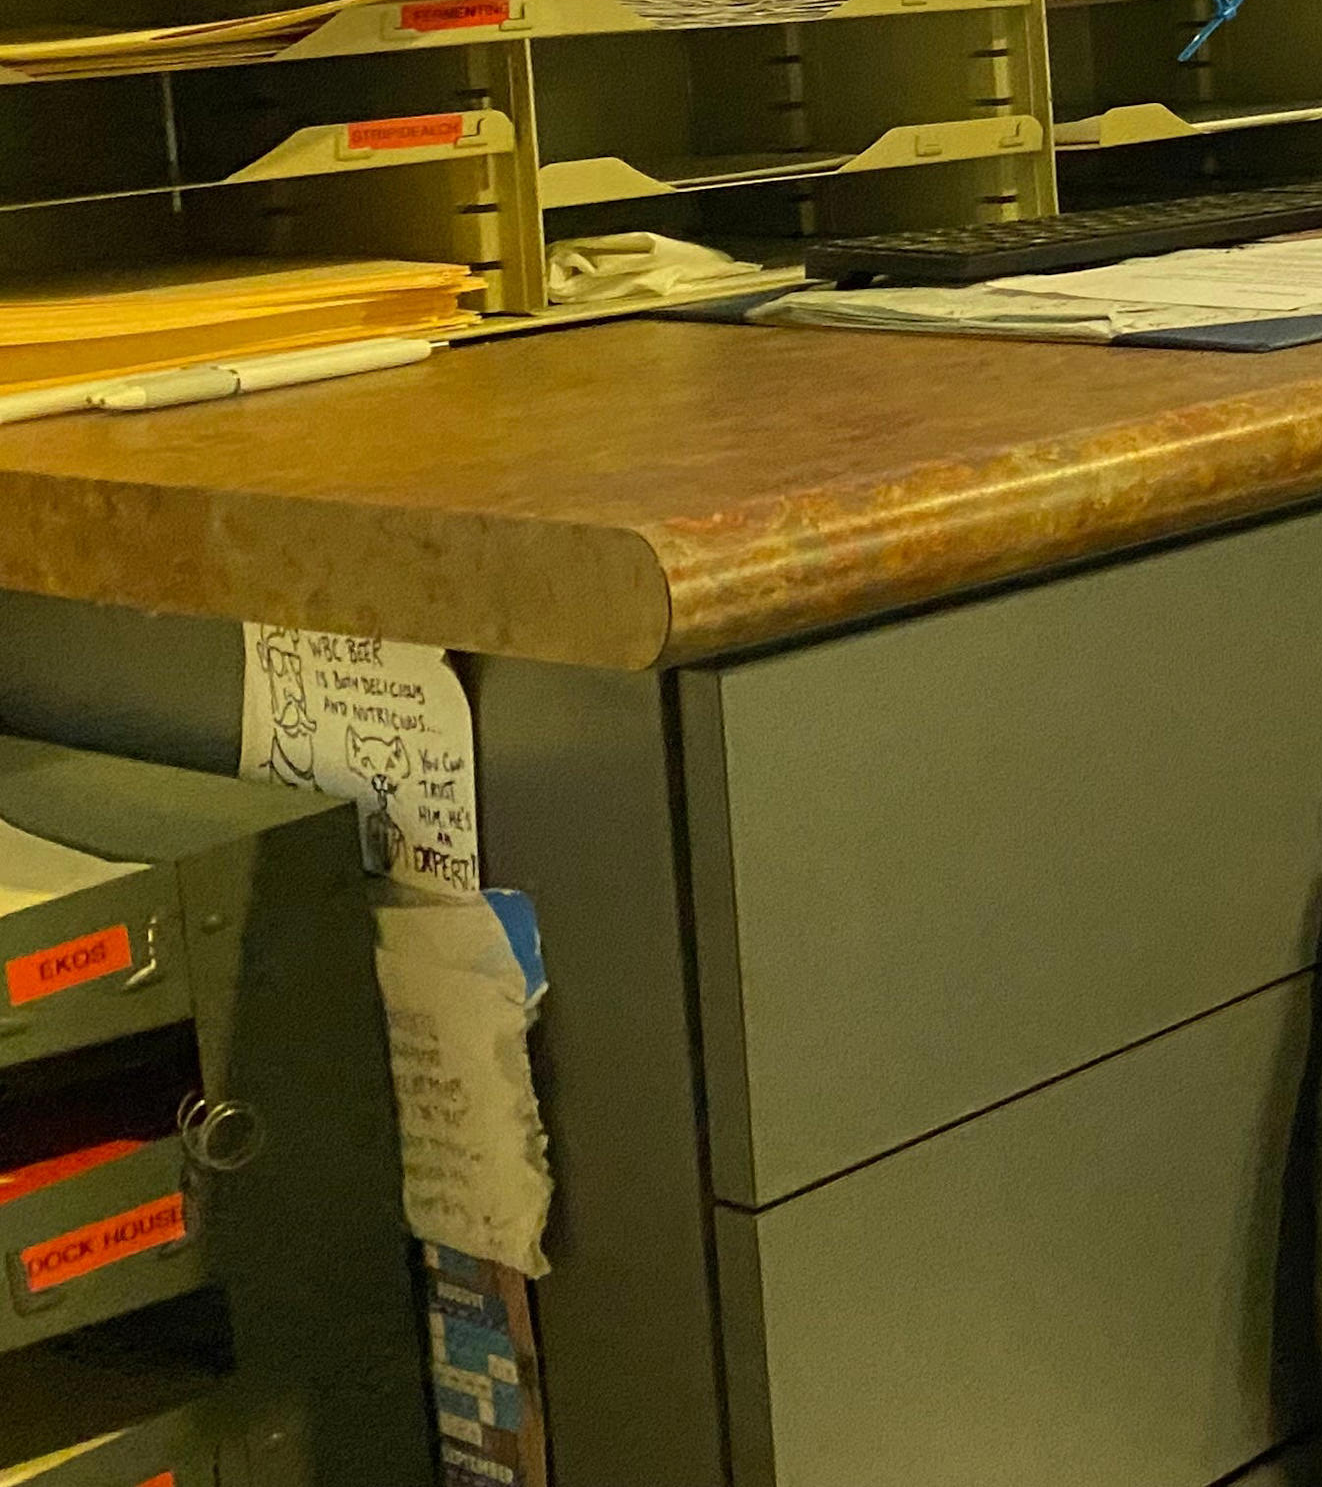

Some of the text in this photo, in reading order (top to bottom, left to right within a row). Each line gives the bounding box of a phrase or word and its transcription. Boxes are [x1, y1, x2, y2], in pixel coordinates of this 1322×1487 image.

[348, 638, 383, 666] BEER
[323, 698, 347, 716] AND
[39, 941, 106, 981] EKOS
[29, 1239, 93, 1274] DOCK
